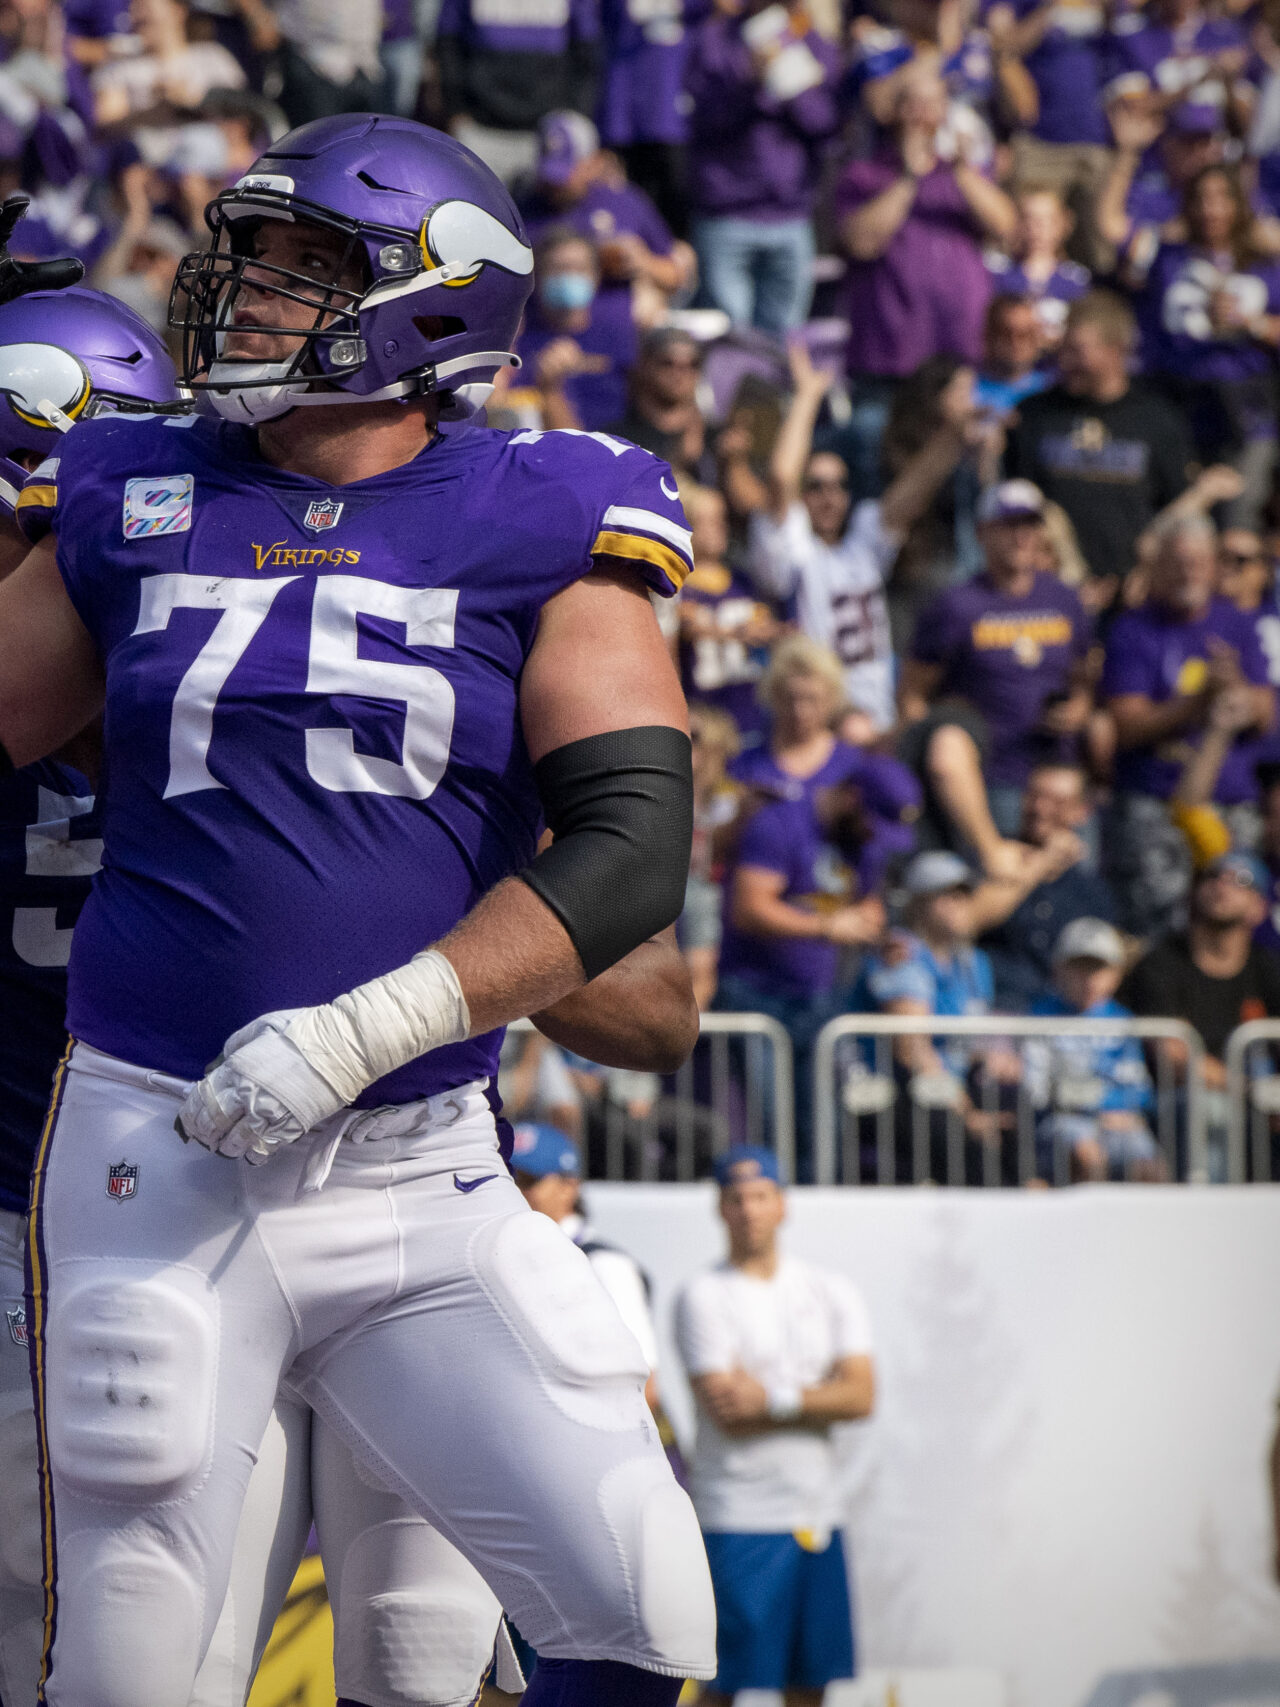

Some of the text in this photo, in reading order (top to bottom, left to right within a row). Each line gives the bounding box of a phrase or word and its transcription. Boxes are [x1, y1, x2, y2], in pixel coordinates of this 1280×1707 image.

[310, 513, 332, 527] NFL
[130, 573, 460, 800] 75
[110, 1177, 133, 1195] NFL
